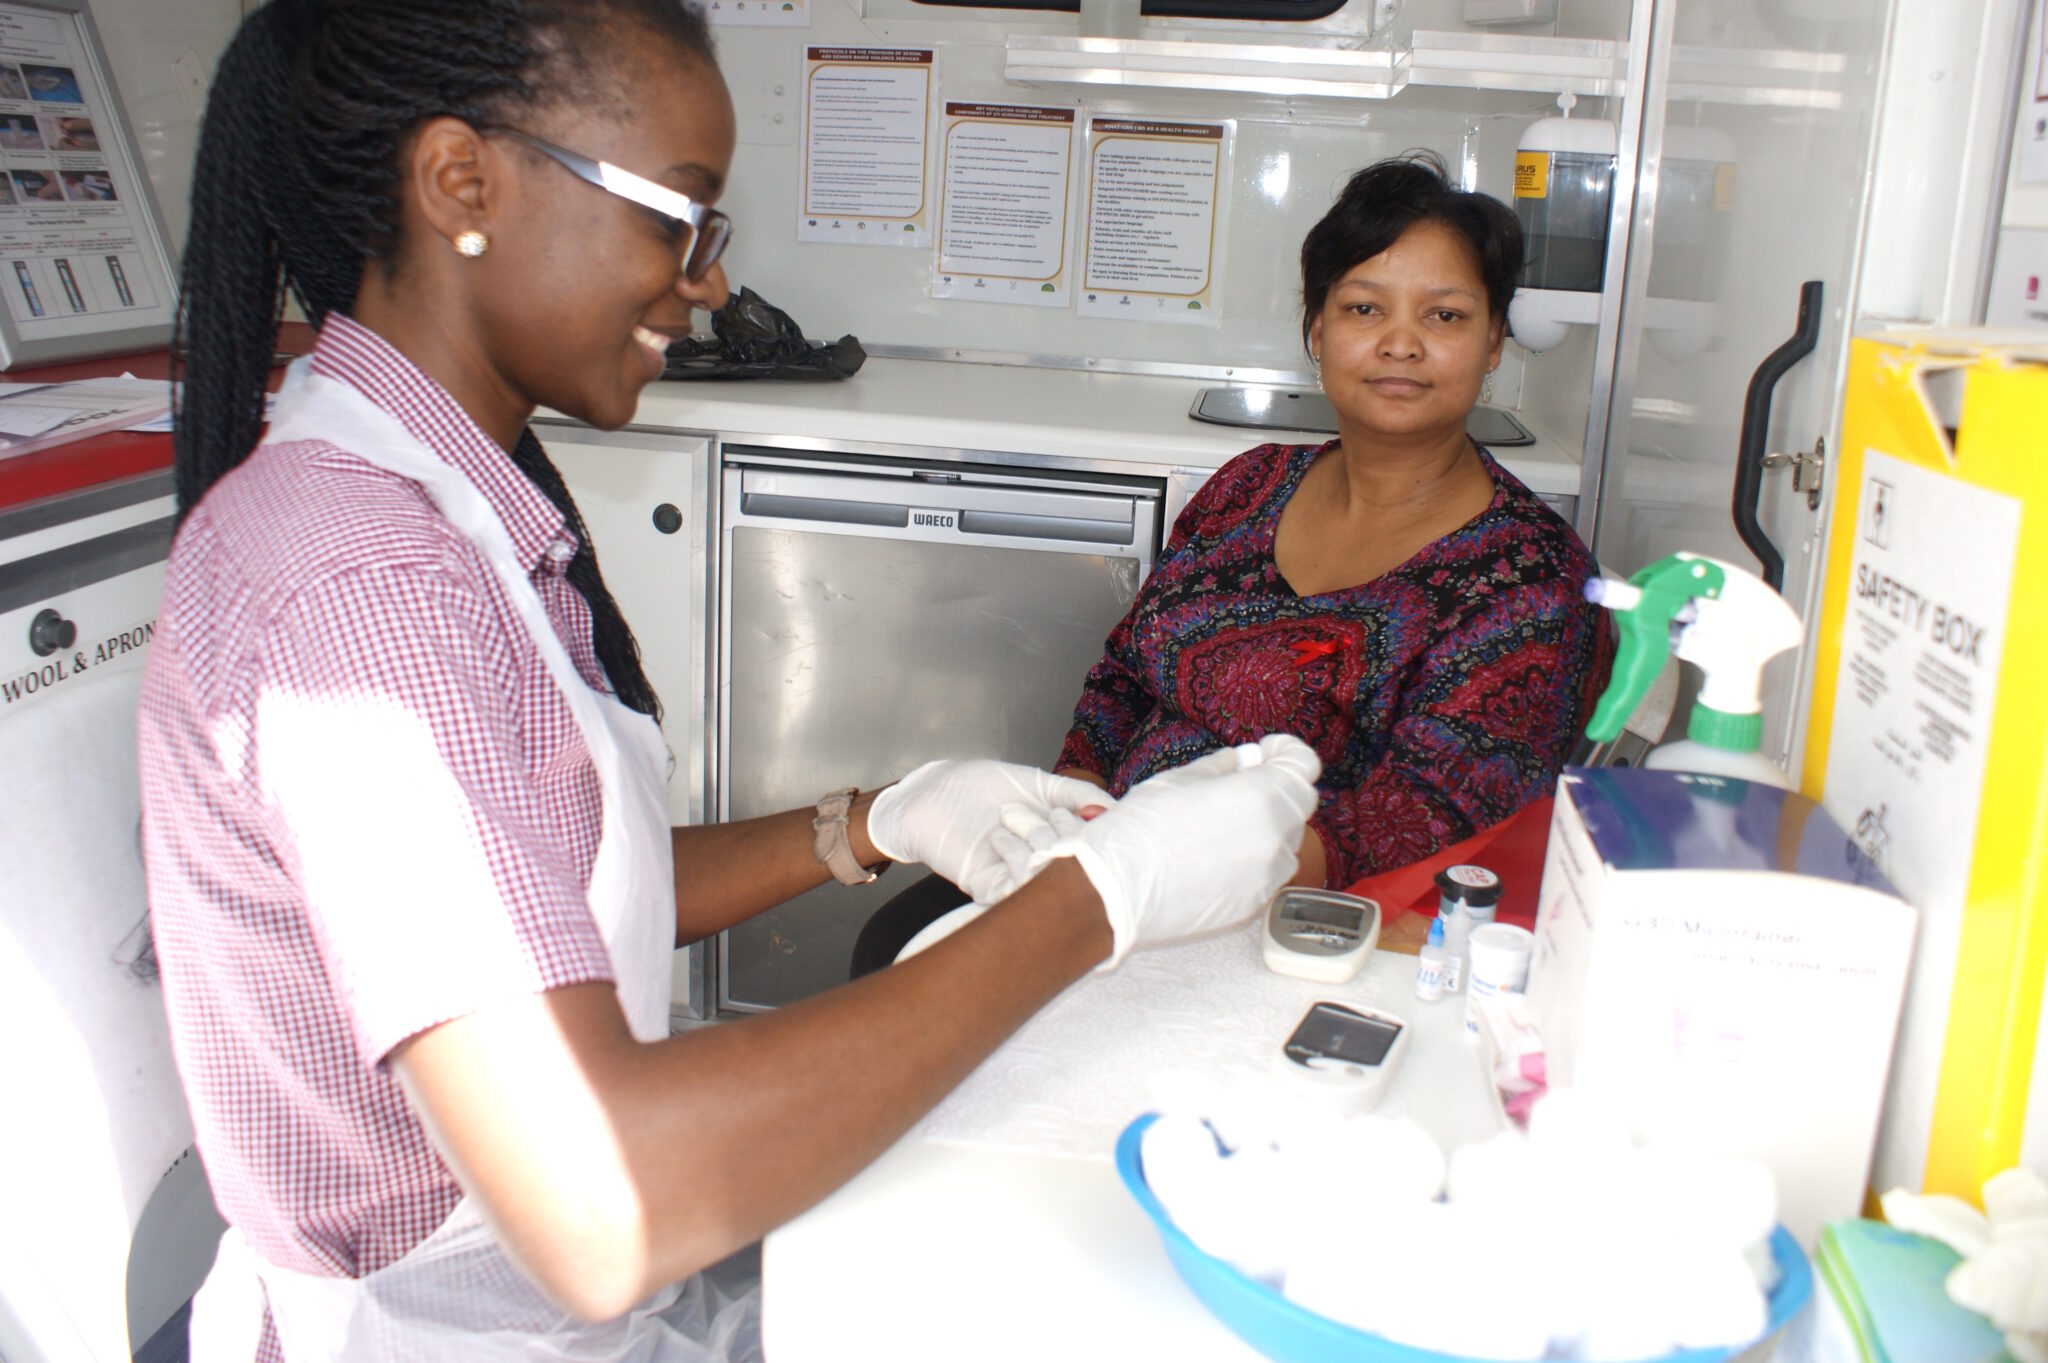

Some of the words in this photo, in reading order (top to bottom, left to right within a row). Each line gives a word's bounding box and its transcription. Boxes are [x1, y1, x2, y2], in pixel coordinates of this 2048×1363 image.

[914, 513, 954, 528] WAECO
[1856, 562, 1930, 632] SAFETY
[1931, 603, 1986, 668] BOX
[2, 660, 68, 704] WOOL
[73, 652, 88, 674] &
[94, 620, 157, 666] APRON
